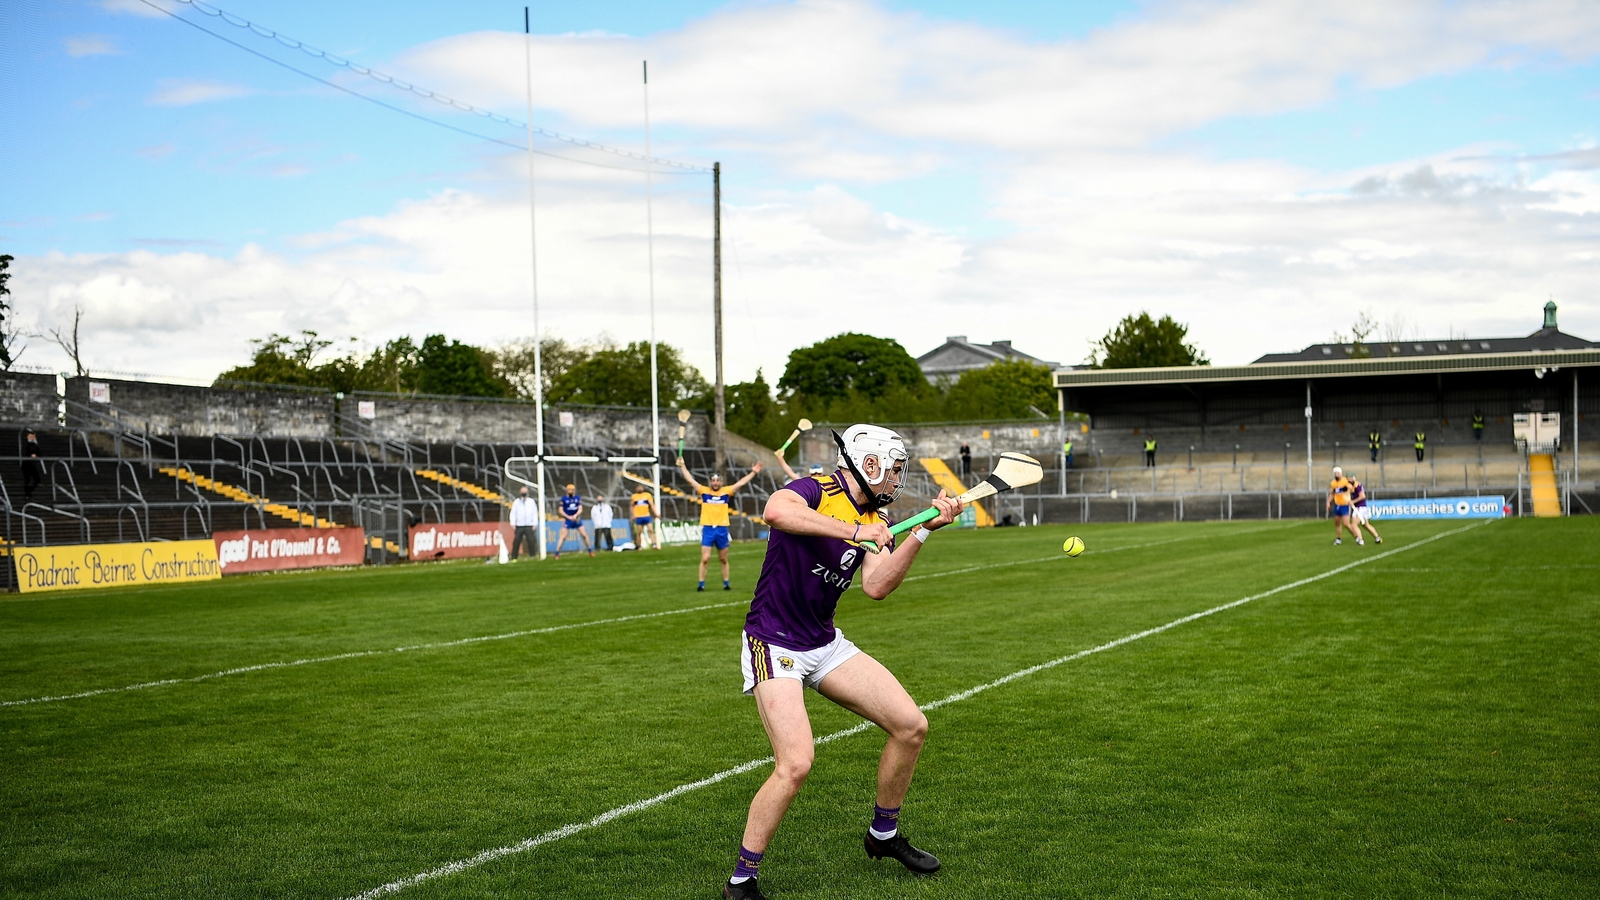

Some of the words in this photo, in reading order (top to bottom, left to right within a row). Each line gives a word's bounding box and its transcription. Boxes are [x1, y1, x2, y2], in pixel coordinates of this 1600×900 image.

[251, 540, 269, 559] Pat
[270, 537, 315, 557] O'Donnell
[316, 536, 325, 554] &
[326, 536, 341, 554] Co.
[436, 532, 450, 548] Pat
[19, 553, 80, 588] Padraic
[84, 550, 136, 584] Beirne
[141, 548, 219, 581] Construction
